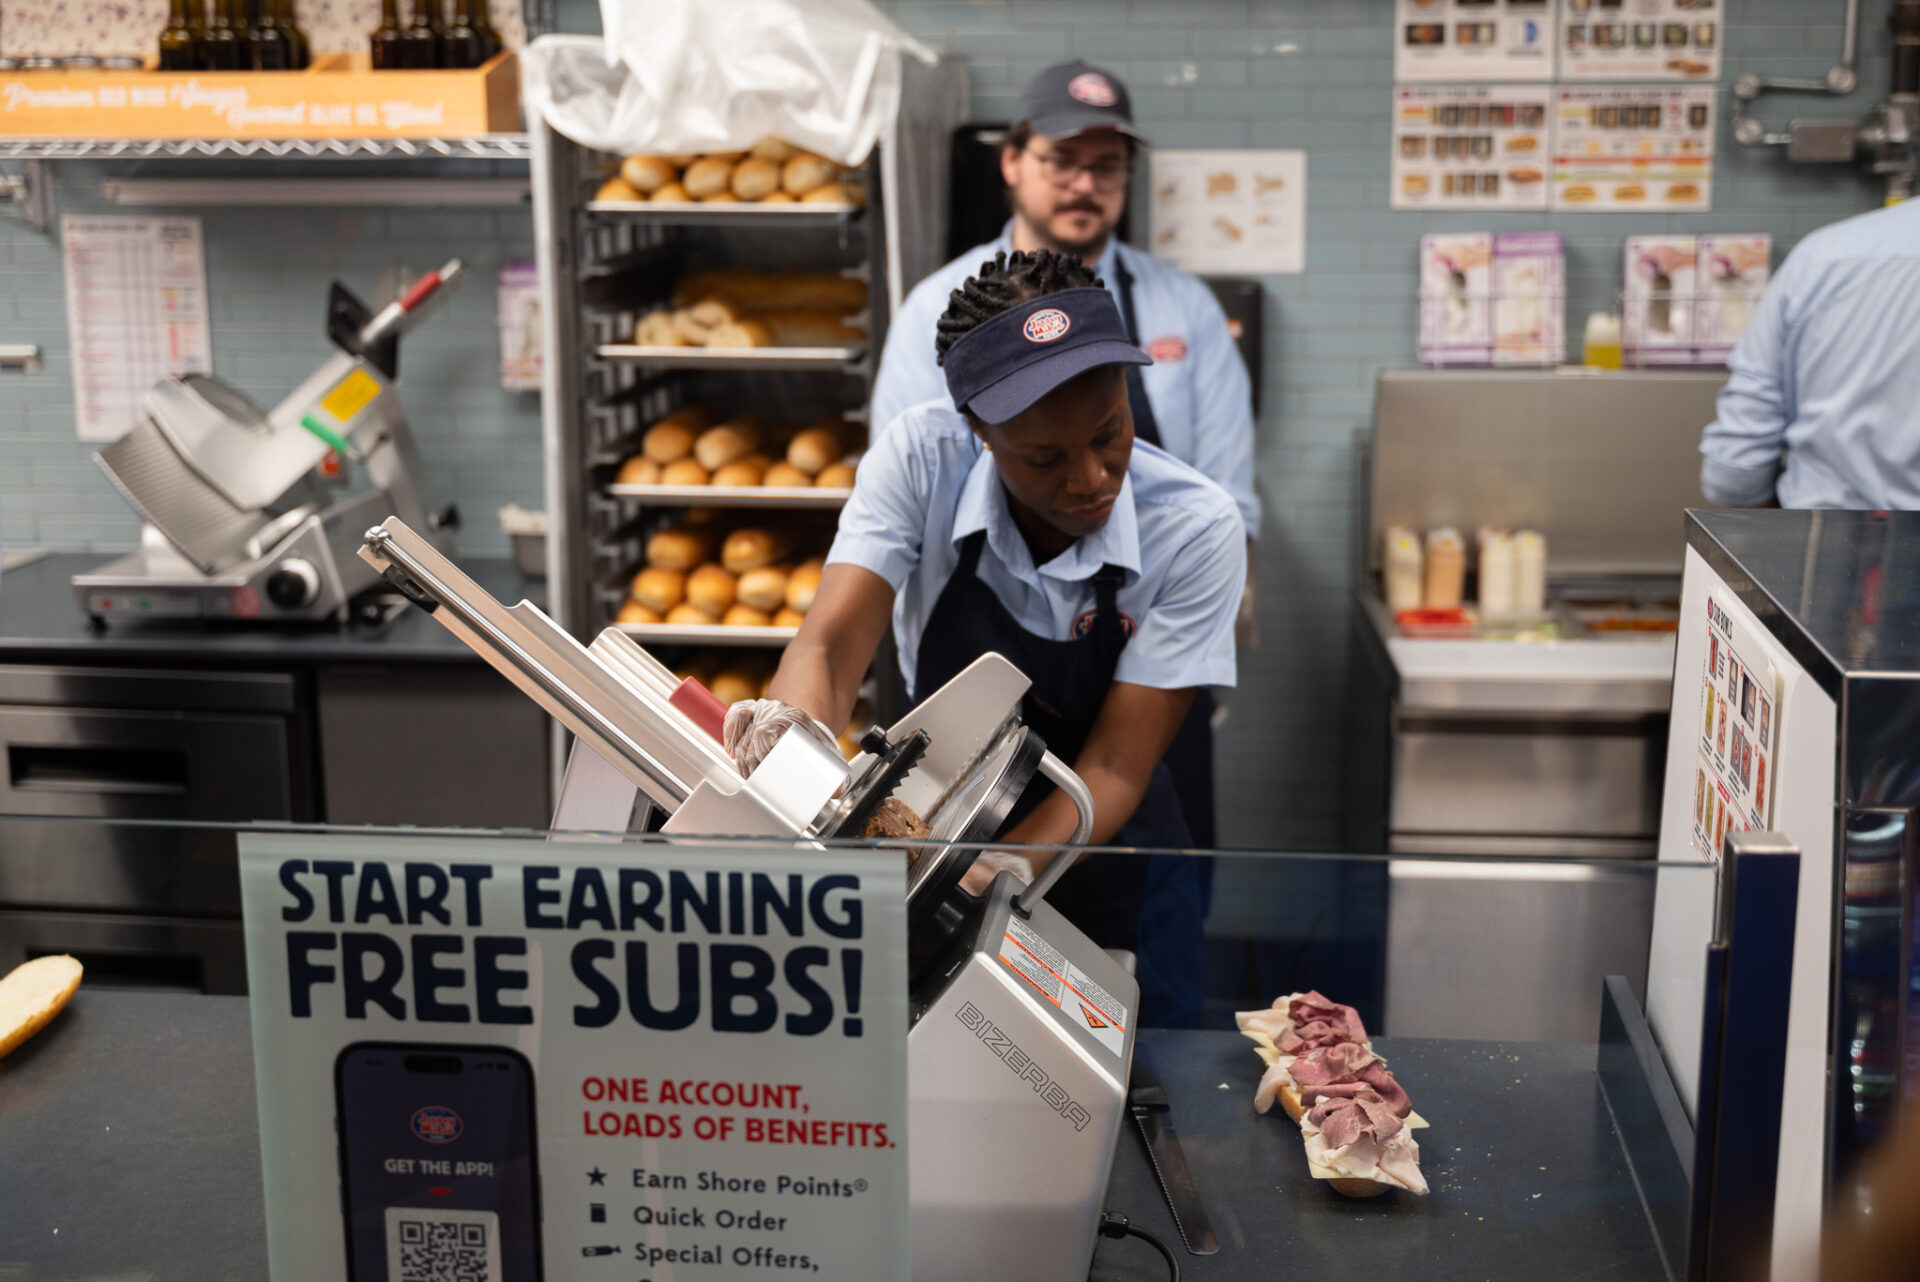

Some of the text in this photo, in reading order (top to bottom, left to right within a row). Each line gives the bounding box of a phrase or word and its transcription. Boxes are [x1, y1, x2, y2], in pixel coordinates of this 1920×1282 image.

[279, 858, 864, 940] START EARNING
[285, 930, 864, 1038] FREE SUBS!
[955, 1000, 1092, 1133] BIZERBA
[582, 1075, 810, 1115] ONE ACCOUNT,
[582, 1111, 896, 1149] LOADS OF BENEFITS.
[384, 1158, 495, 1177] GET THE APP!
[632, 1168, 687, 1191] Earn
[697, 1171, 767, 1194] Shore
[633, 1205, 788, 1232] Quick Order
[635, 1242, 820, 1273] Special Offers,
